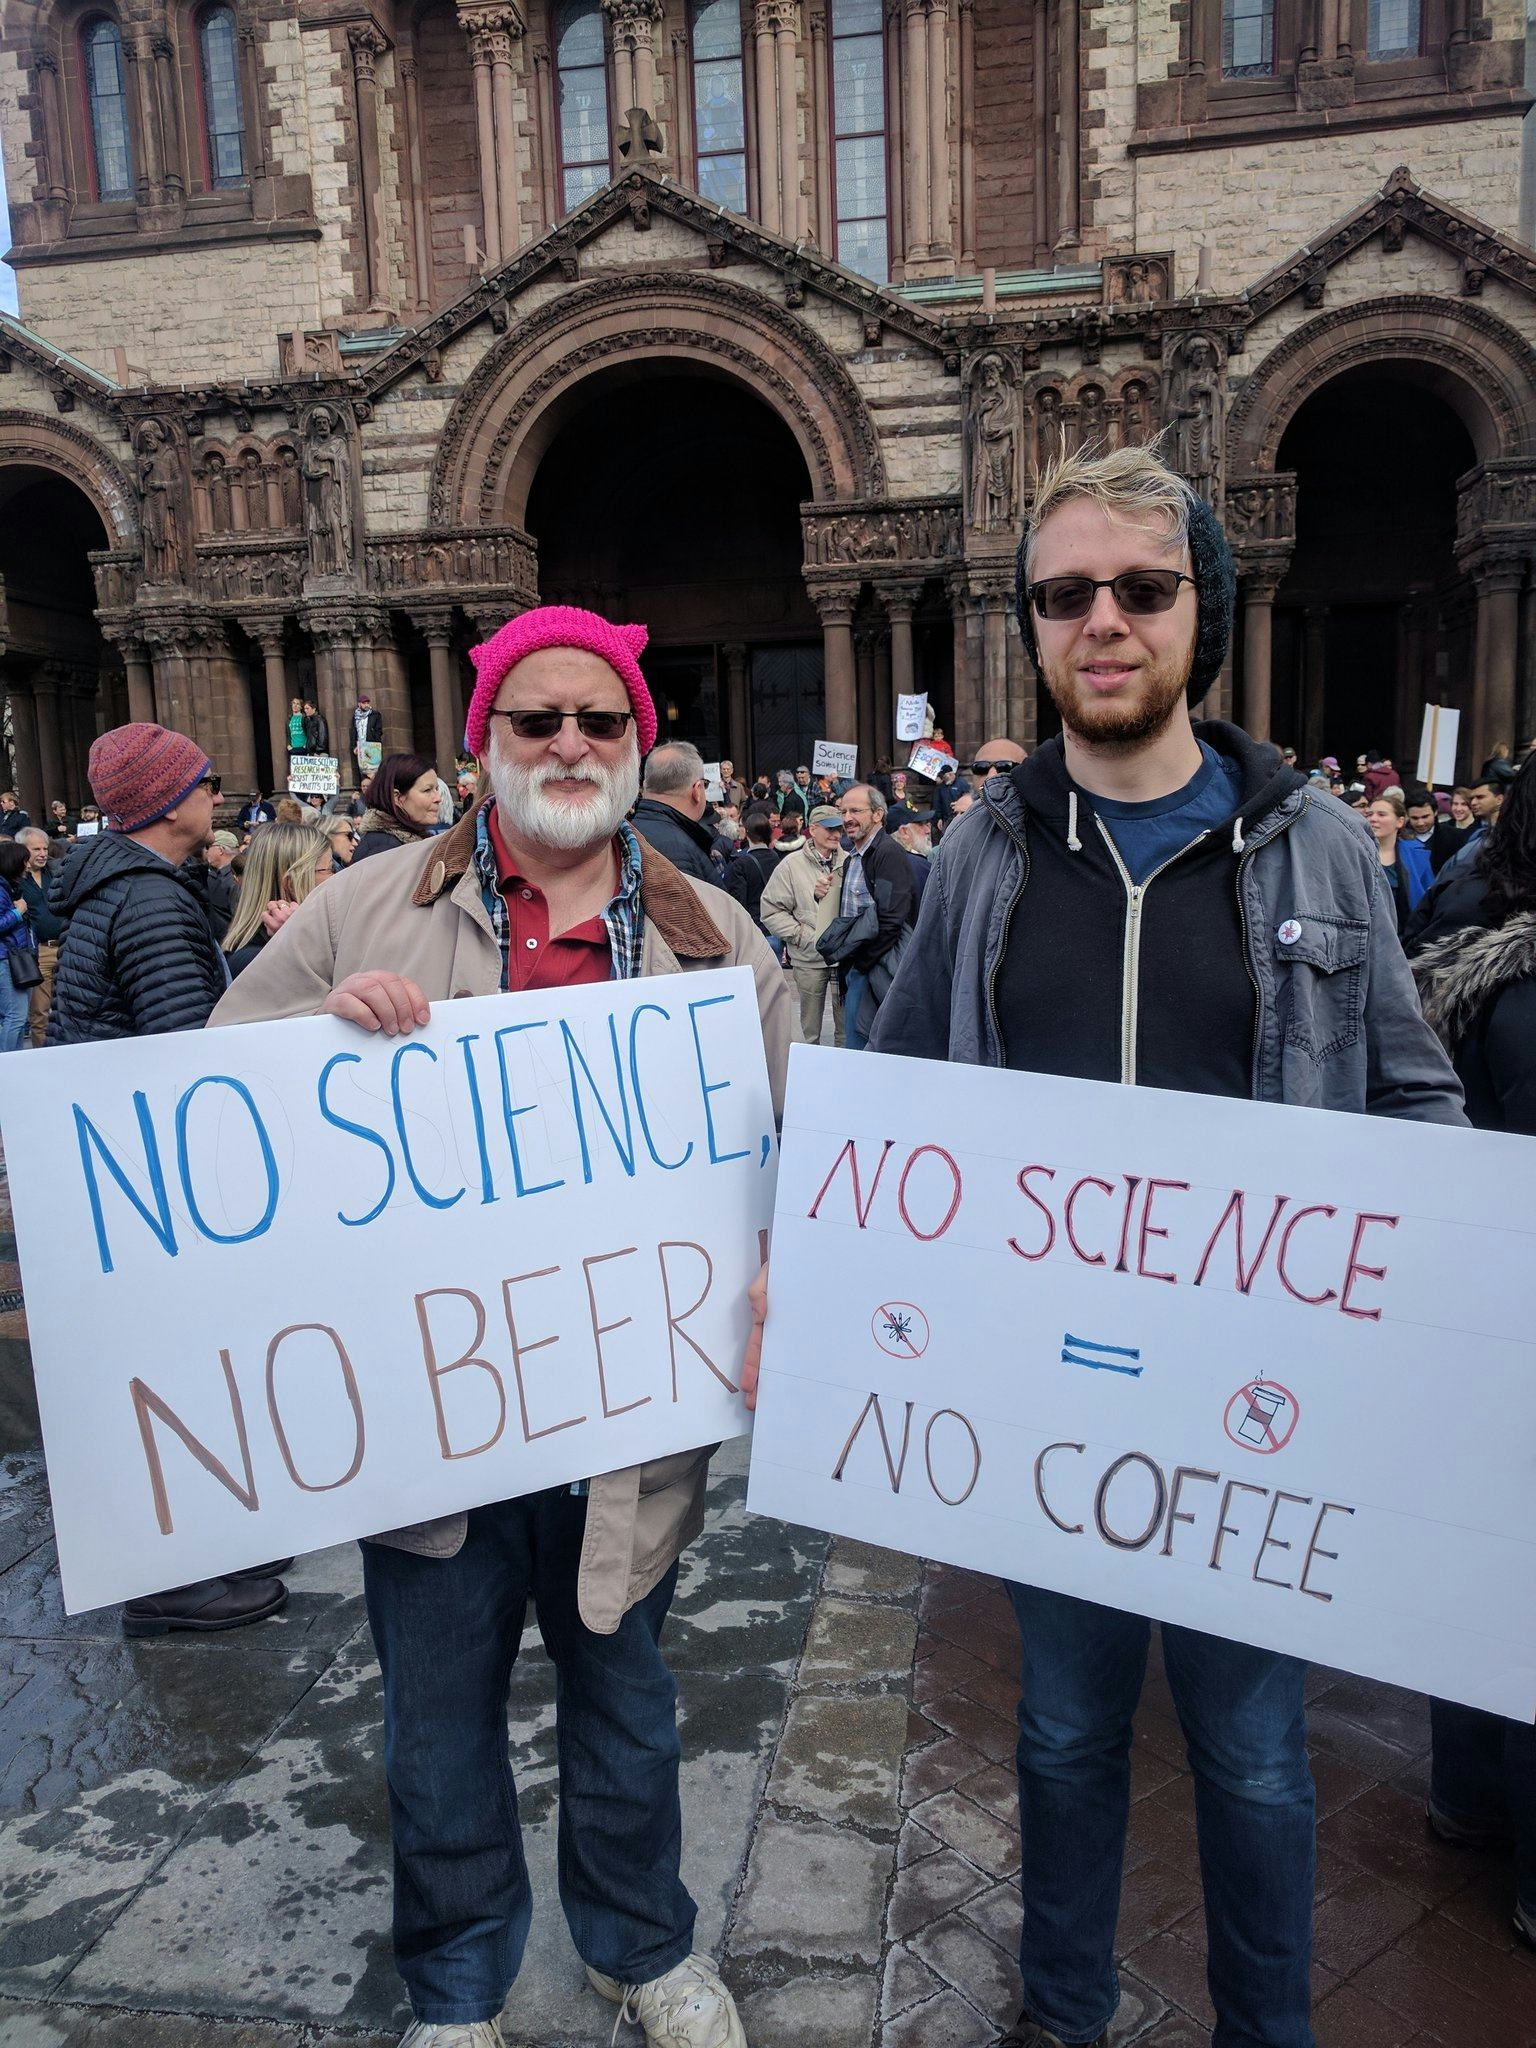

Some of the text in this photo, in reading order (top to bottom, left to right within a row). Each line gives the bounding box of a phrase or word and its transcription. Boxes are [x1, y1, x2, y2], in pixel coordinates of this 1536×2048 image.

[818, 744, 855, 760] Science
[71, 995, 772, 1275] NO SCIENCE,
[808, 1139, 1399, 1321] NO SCIENCE
[130, 1323, 364, 1534] NO
[831, 1392, 1356, 1603] NO COFFEE
